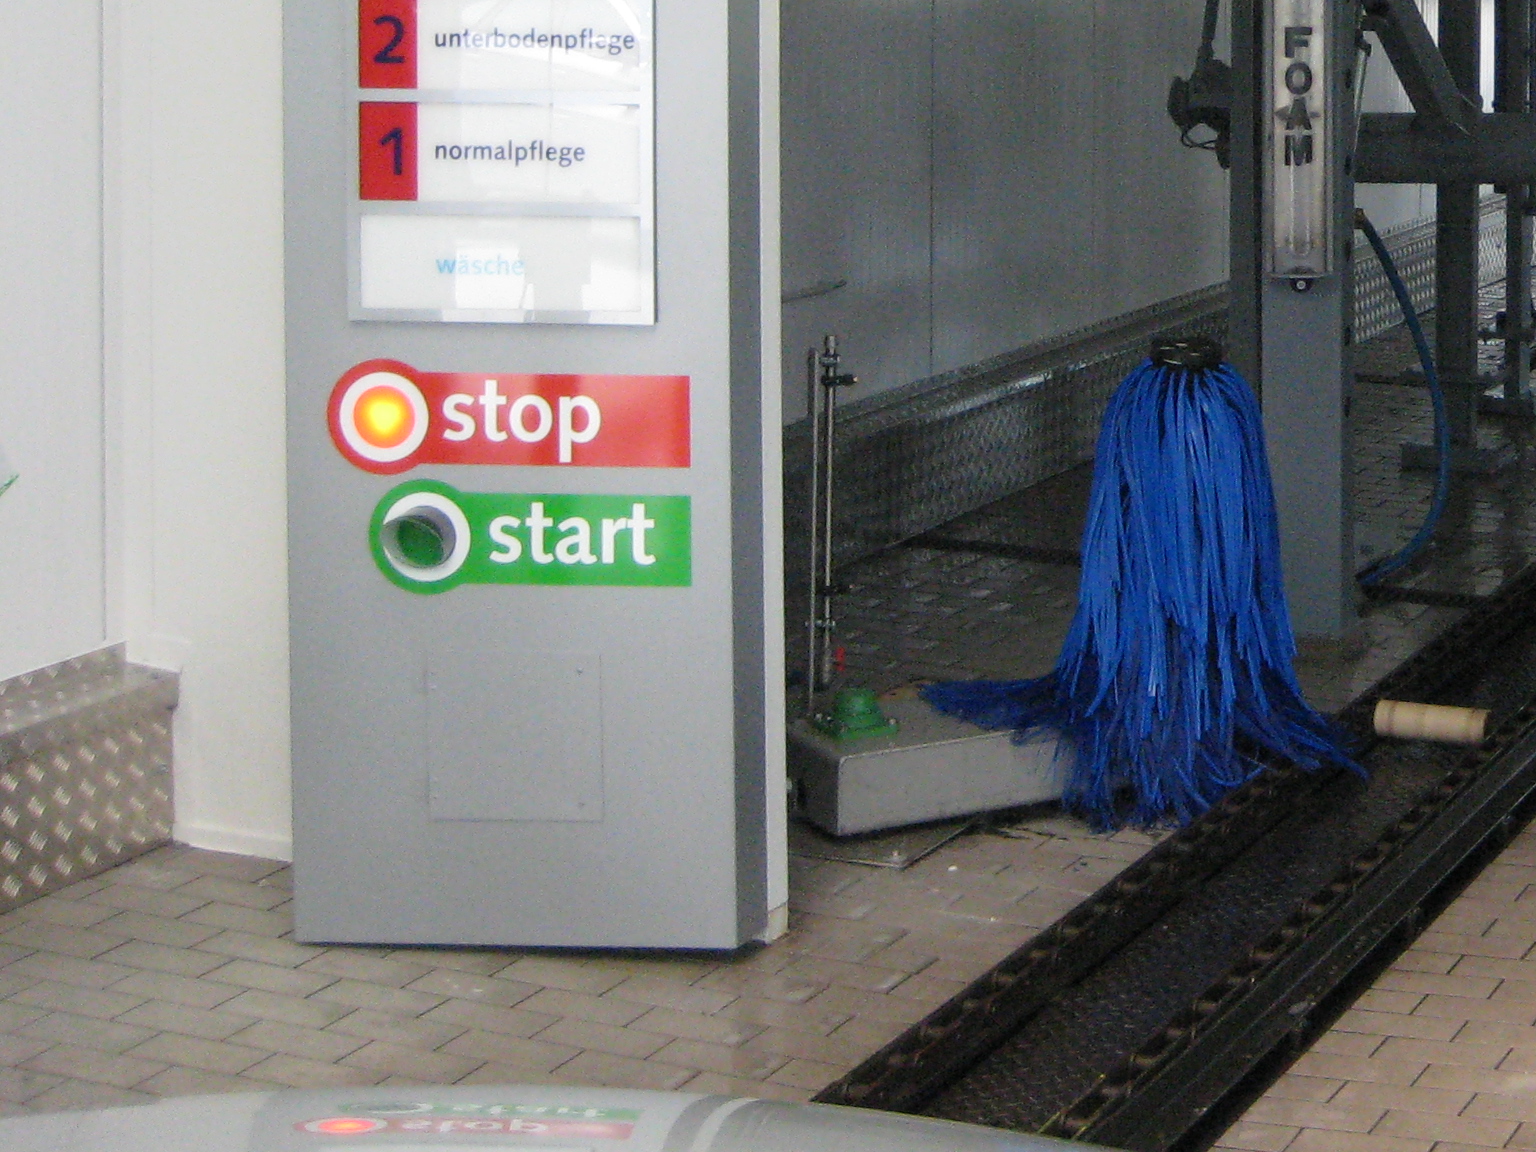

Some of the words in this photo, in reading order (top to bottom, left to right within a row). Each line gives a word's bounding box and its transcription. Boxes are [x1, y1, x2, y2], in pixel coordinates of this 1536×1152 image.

[373, 16, 405, 64] 2
[434, 28, 635, 54] unterbodenpflege
[1284, 27, 1313, 166] FOAM
[379, 128, 403, 175] 1
[434, 141, 585, 167] normalpflege
[436, 253, 524, 275] wäsche
[442, 380, 601, 462] stop
[489, 502, 655, 565] start
